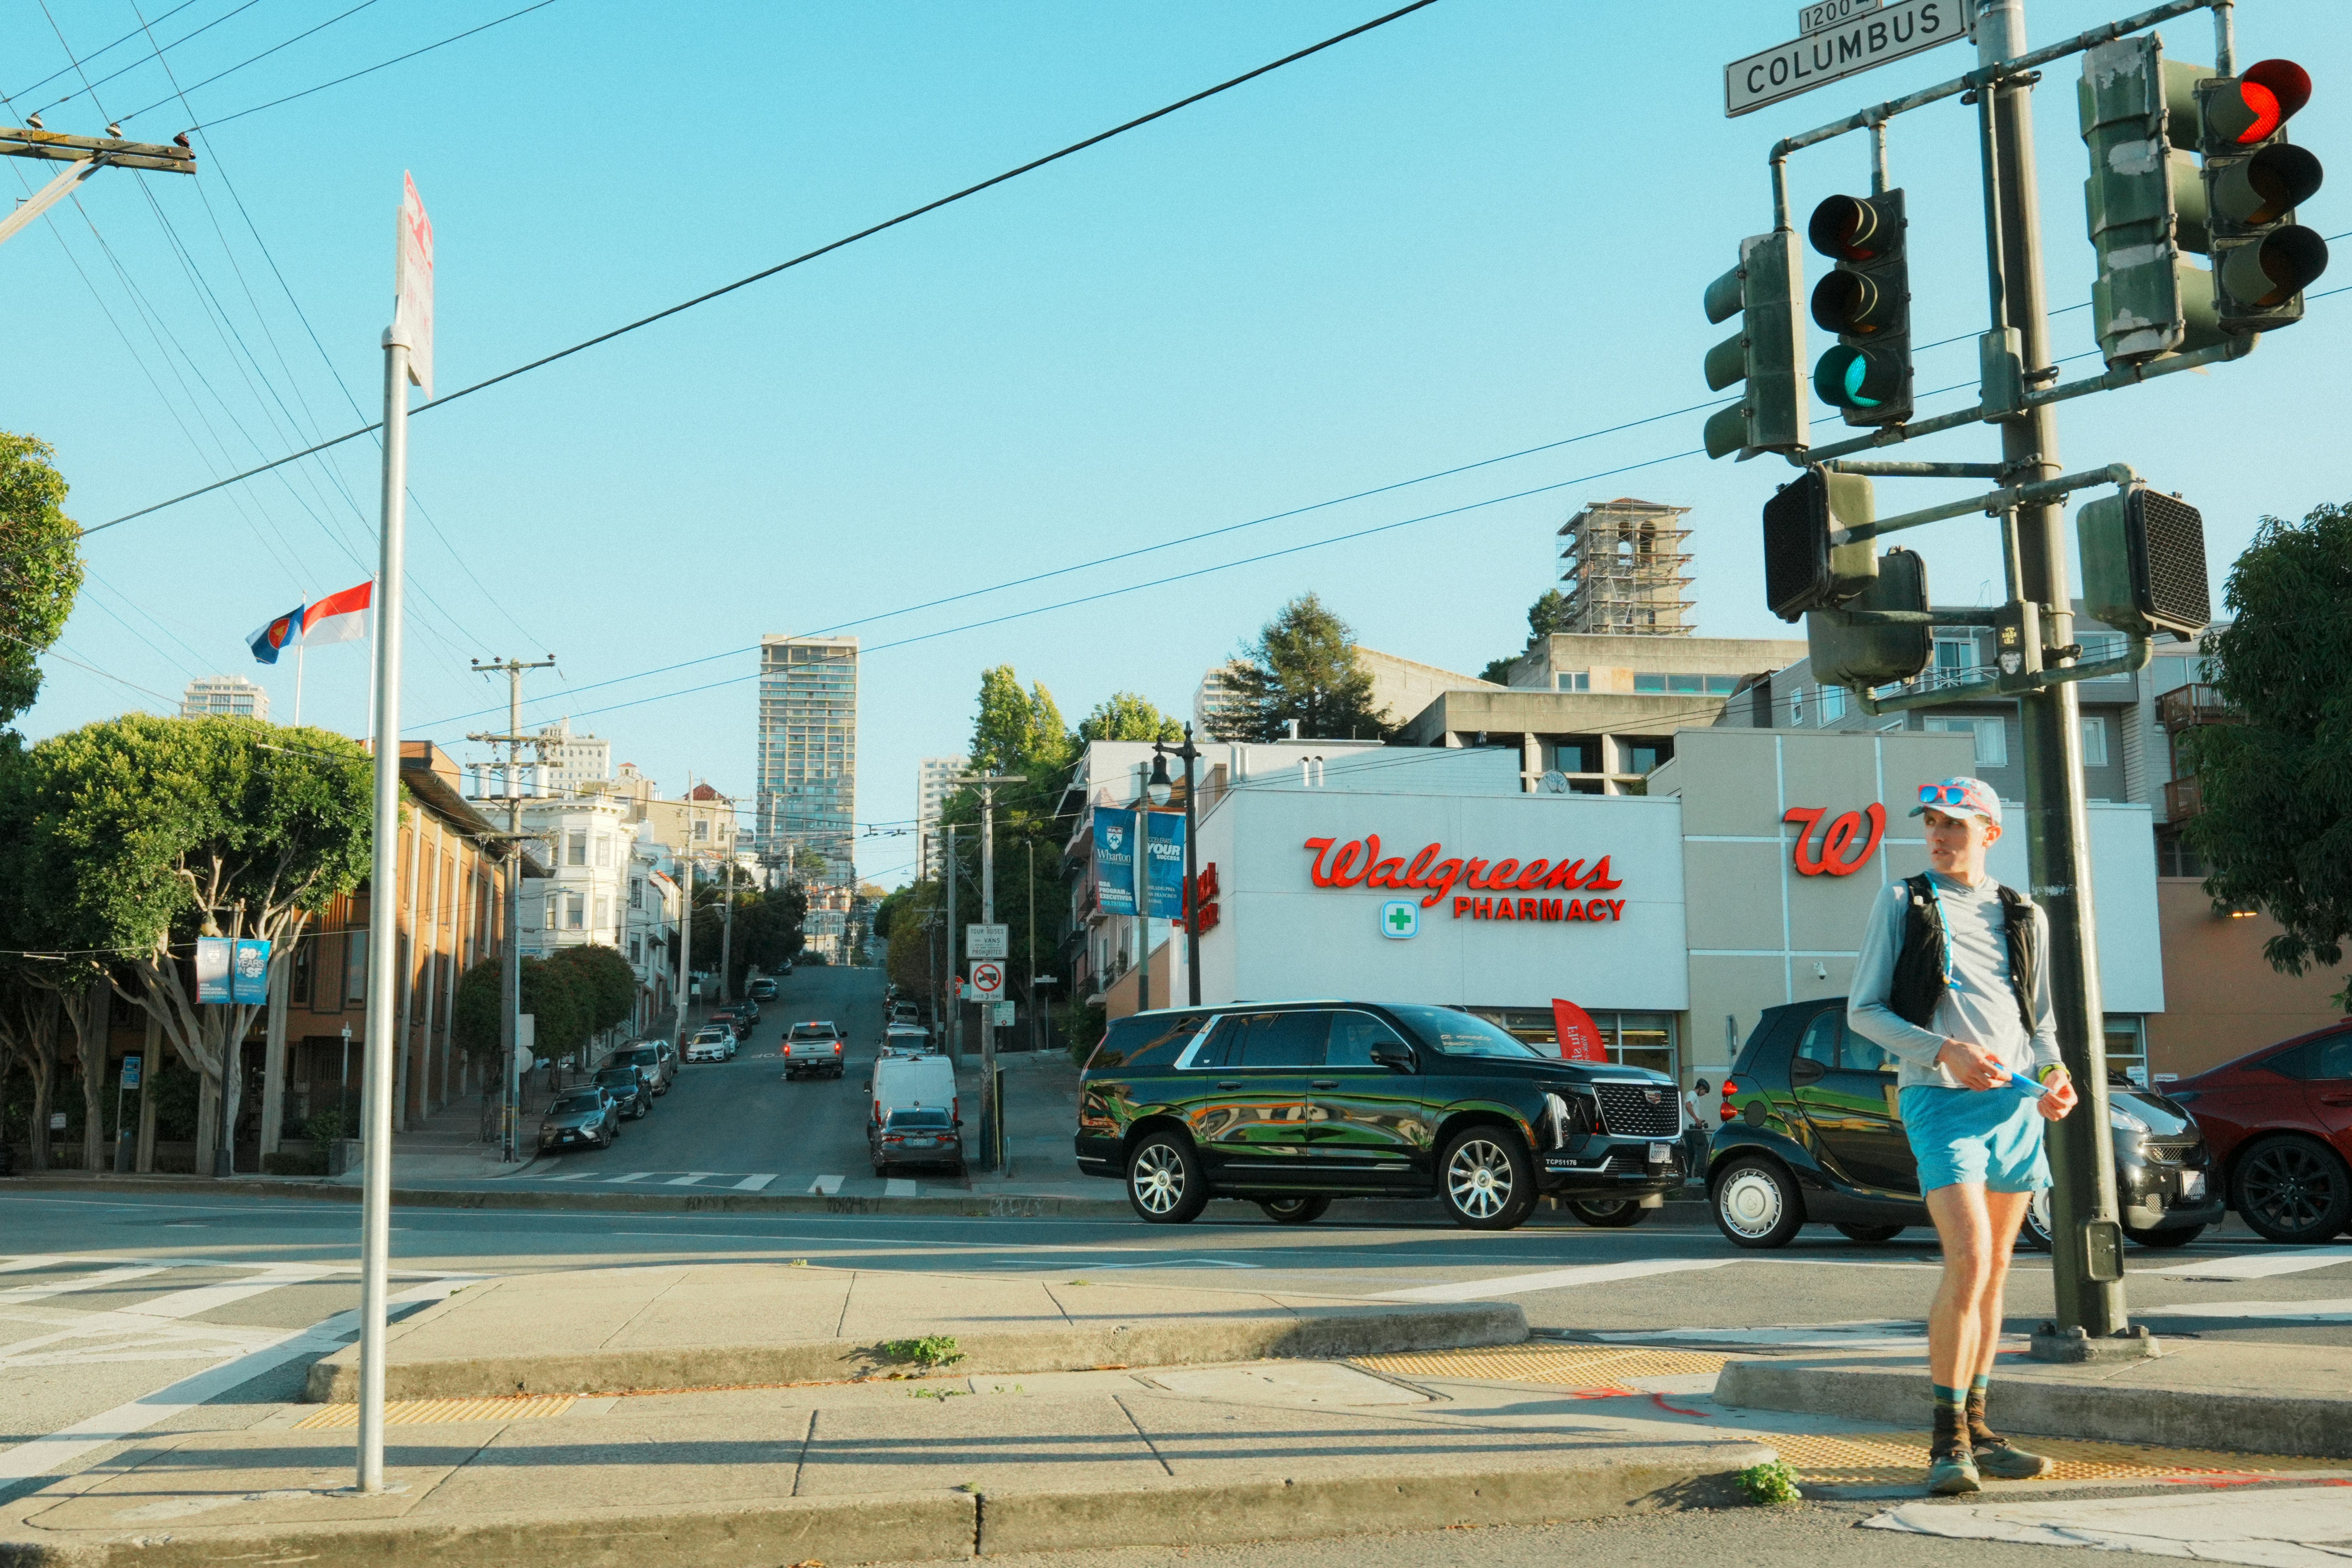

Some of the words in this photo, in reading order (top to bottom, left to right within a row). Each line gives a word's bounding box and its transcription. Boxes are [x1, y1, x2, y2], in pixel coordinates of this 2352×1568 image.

[1805, 0, 1850, 29] 1200
[1747, 10, 1940, 94] COLUMBUS
[1148, 836, 1172, 844] CCELERATE
[1782, 802, 1886, 876] W
[1097, 848, 1131, 862] Wharton
[1148, 843, 1181, 856] YOUR
[1304, 834, 1623, 909] Walgreens
[1099, 893, 1133, 901] EXECUTIVES
[1453, 896, 1626, 922] PHARMACY
[239, 948, 263, 959] 20+
[236, 958, 264, 968] YEARS
[245, 967, 263, 978] SF
